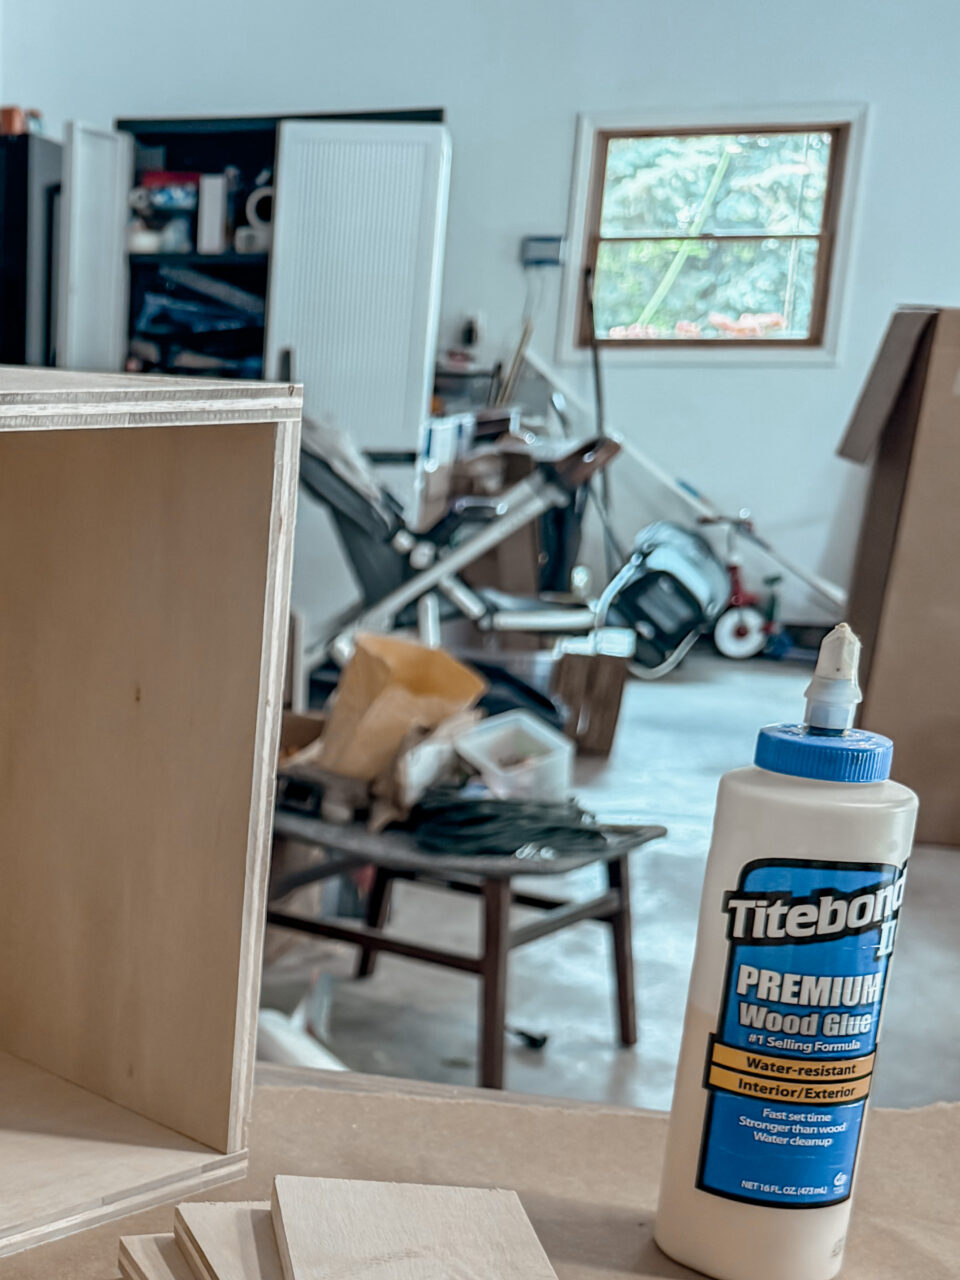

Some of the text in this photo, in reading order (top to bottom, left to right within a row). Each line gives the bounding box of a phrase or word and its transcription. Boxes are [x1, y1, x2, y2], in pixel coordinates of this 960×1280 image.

[737, 965, 882, 1007] PREMIUM
[740, 1003, 872, 1036] Wood Glue
[748, 1034, 860, 1053] #1 Selling Formula
[746, 1057, 856, 1076] Water-resistant
[738, 1078, 856, 1100] Interior/Exterior
[763, 1108, 832, 1122] Fast set time
[739, 1116, 846, 1134] Stronger than wood
[753, 1131, 833, 1148] Water cleanup
[741, 1180, 758, 1190] NET
